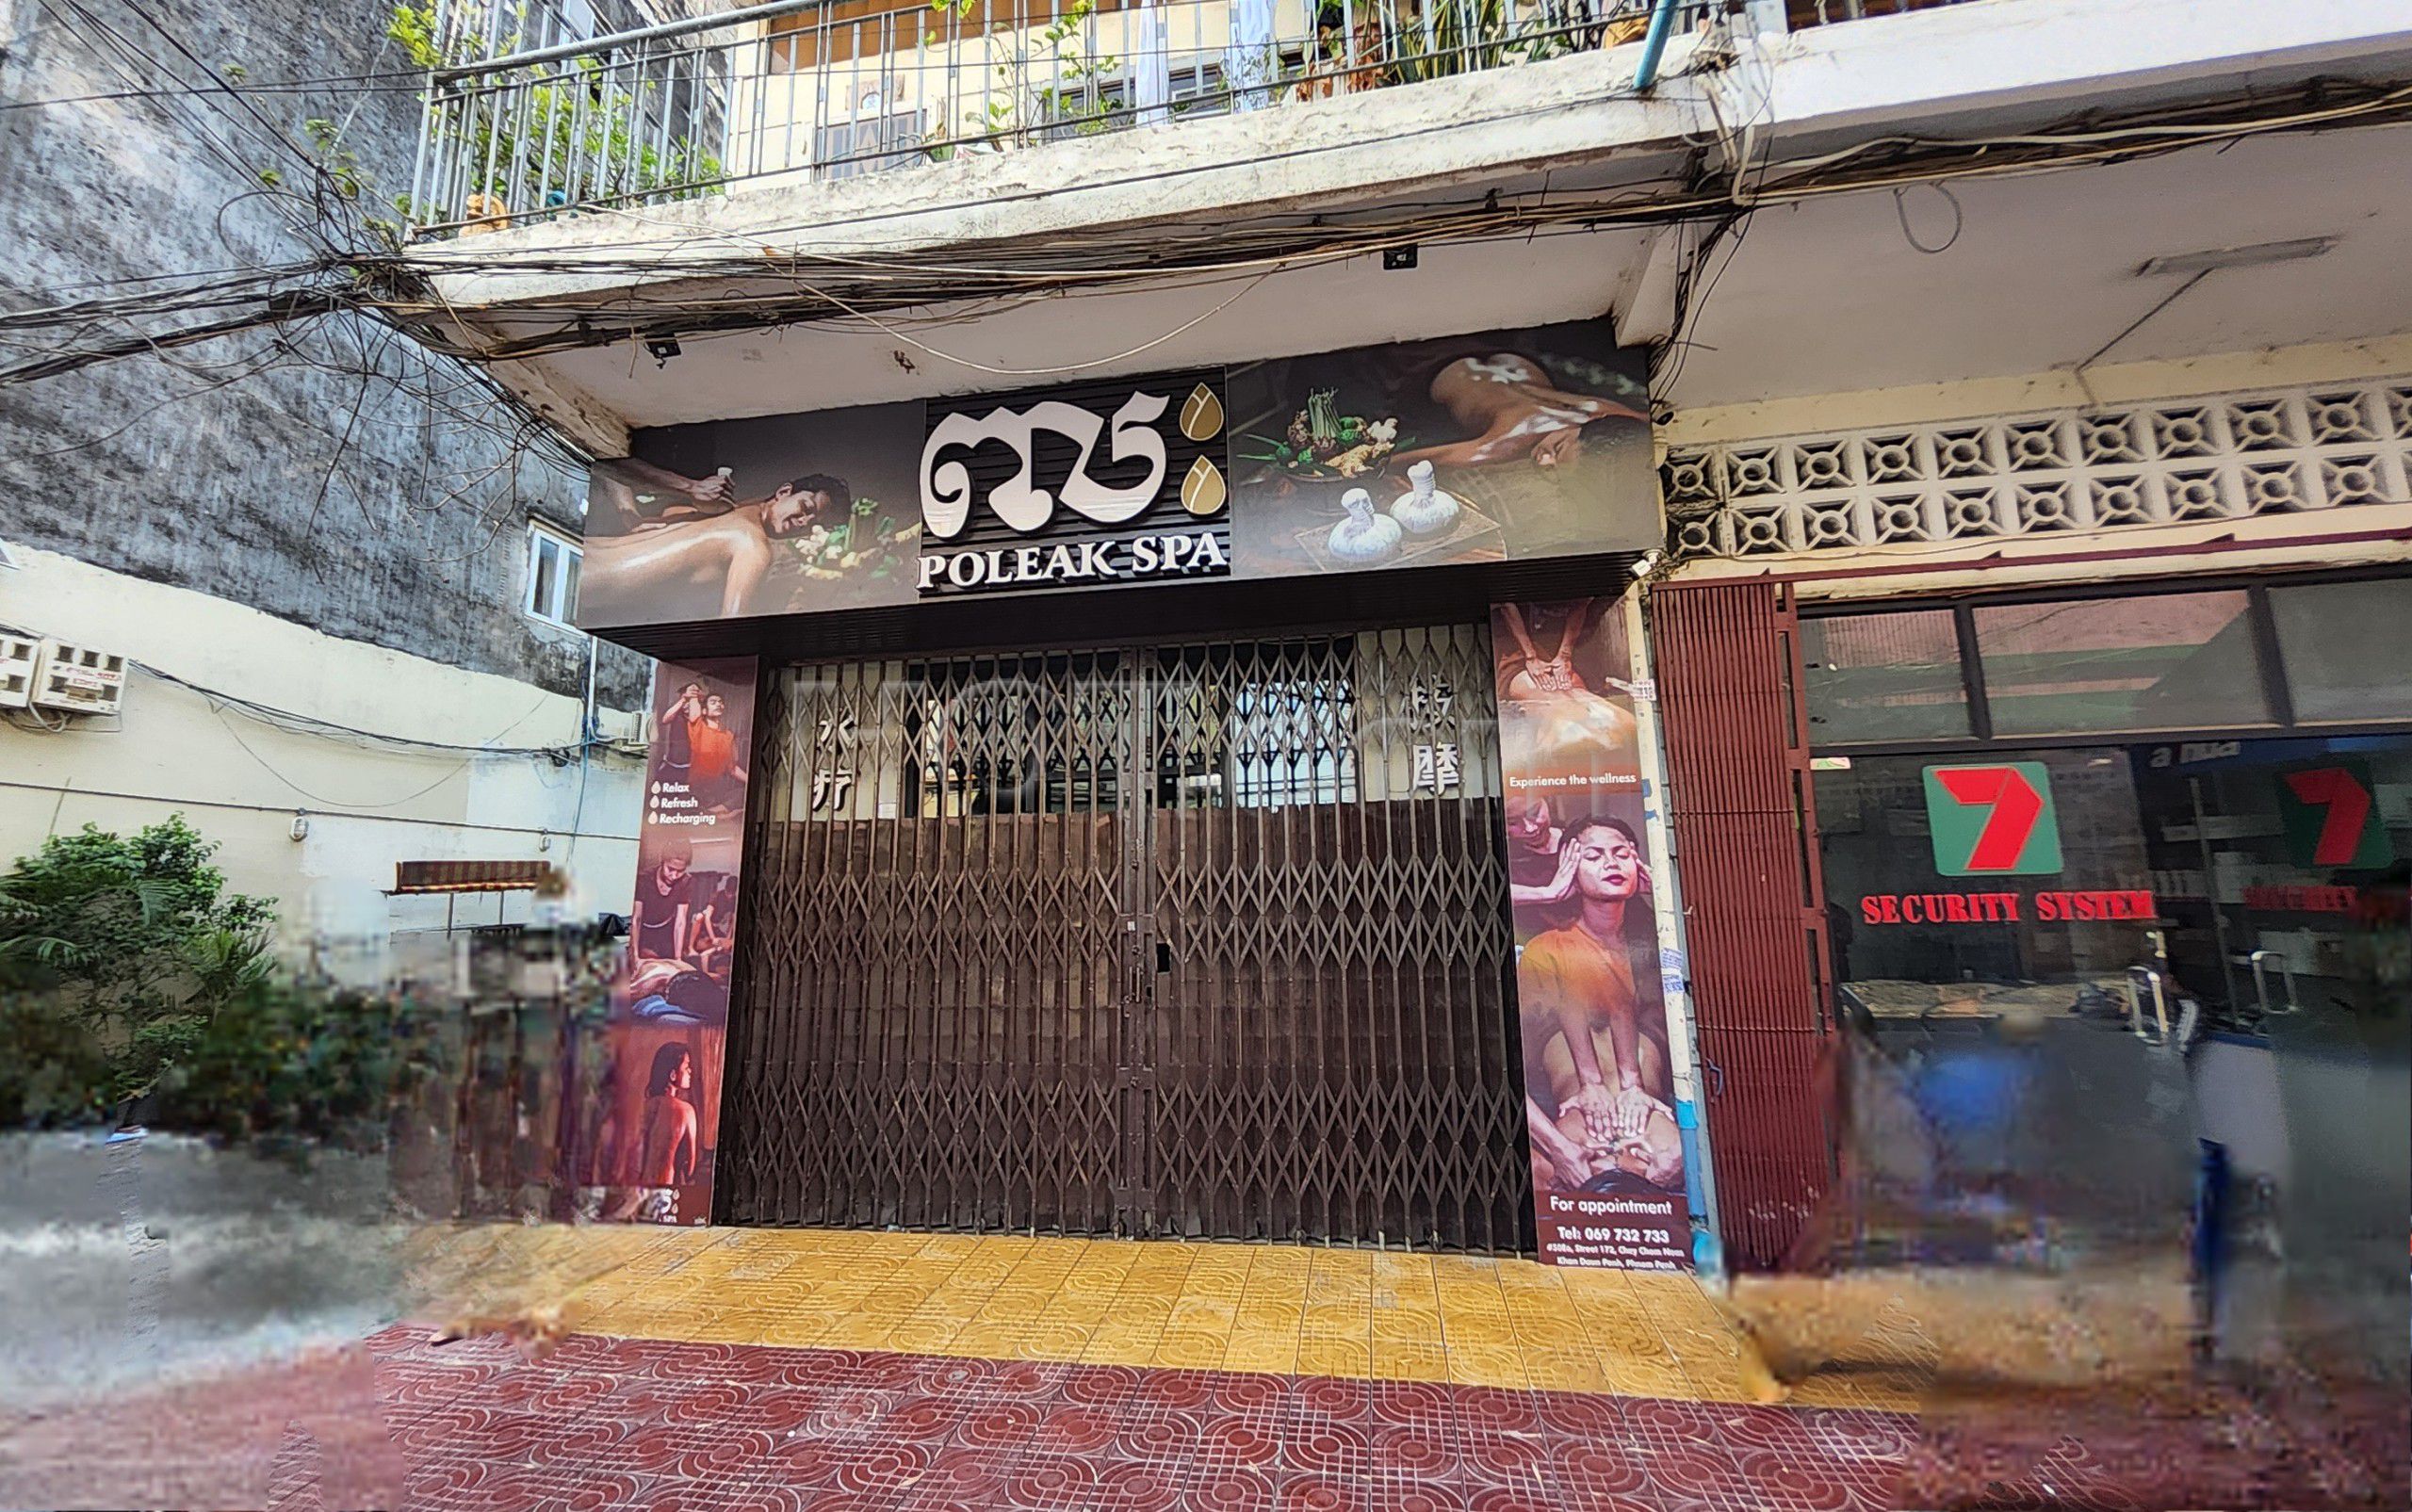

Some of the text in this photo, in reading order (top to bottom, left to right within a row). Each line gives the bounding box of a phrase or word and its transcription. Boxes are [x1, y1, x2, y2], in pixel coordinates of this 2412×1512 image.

[916, 531, 1229, 591] POLEAK SPA
[662, 781, 690, 793] Relax
[1509, 772, 1638, 789] Experience the wellness
[660, 796, 698, 808] Refresh
[660, 812, 716, 825] Recharging
[1860, 889, 2158, 924] SECURITY SYSTEM
[1550, 1195, 1672, 1216] For appointment
[1556, 1226, 1670, 1244] Tel: 069 732 733
